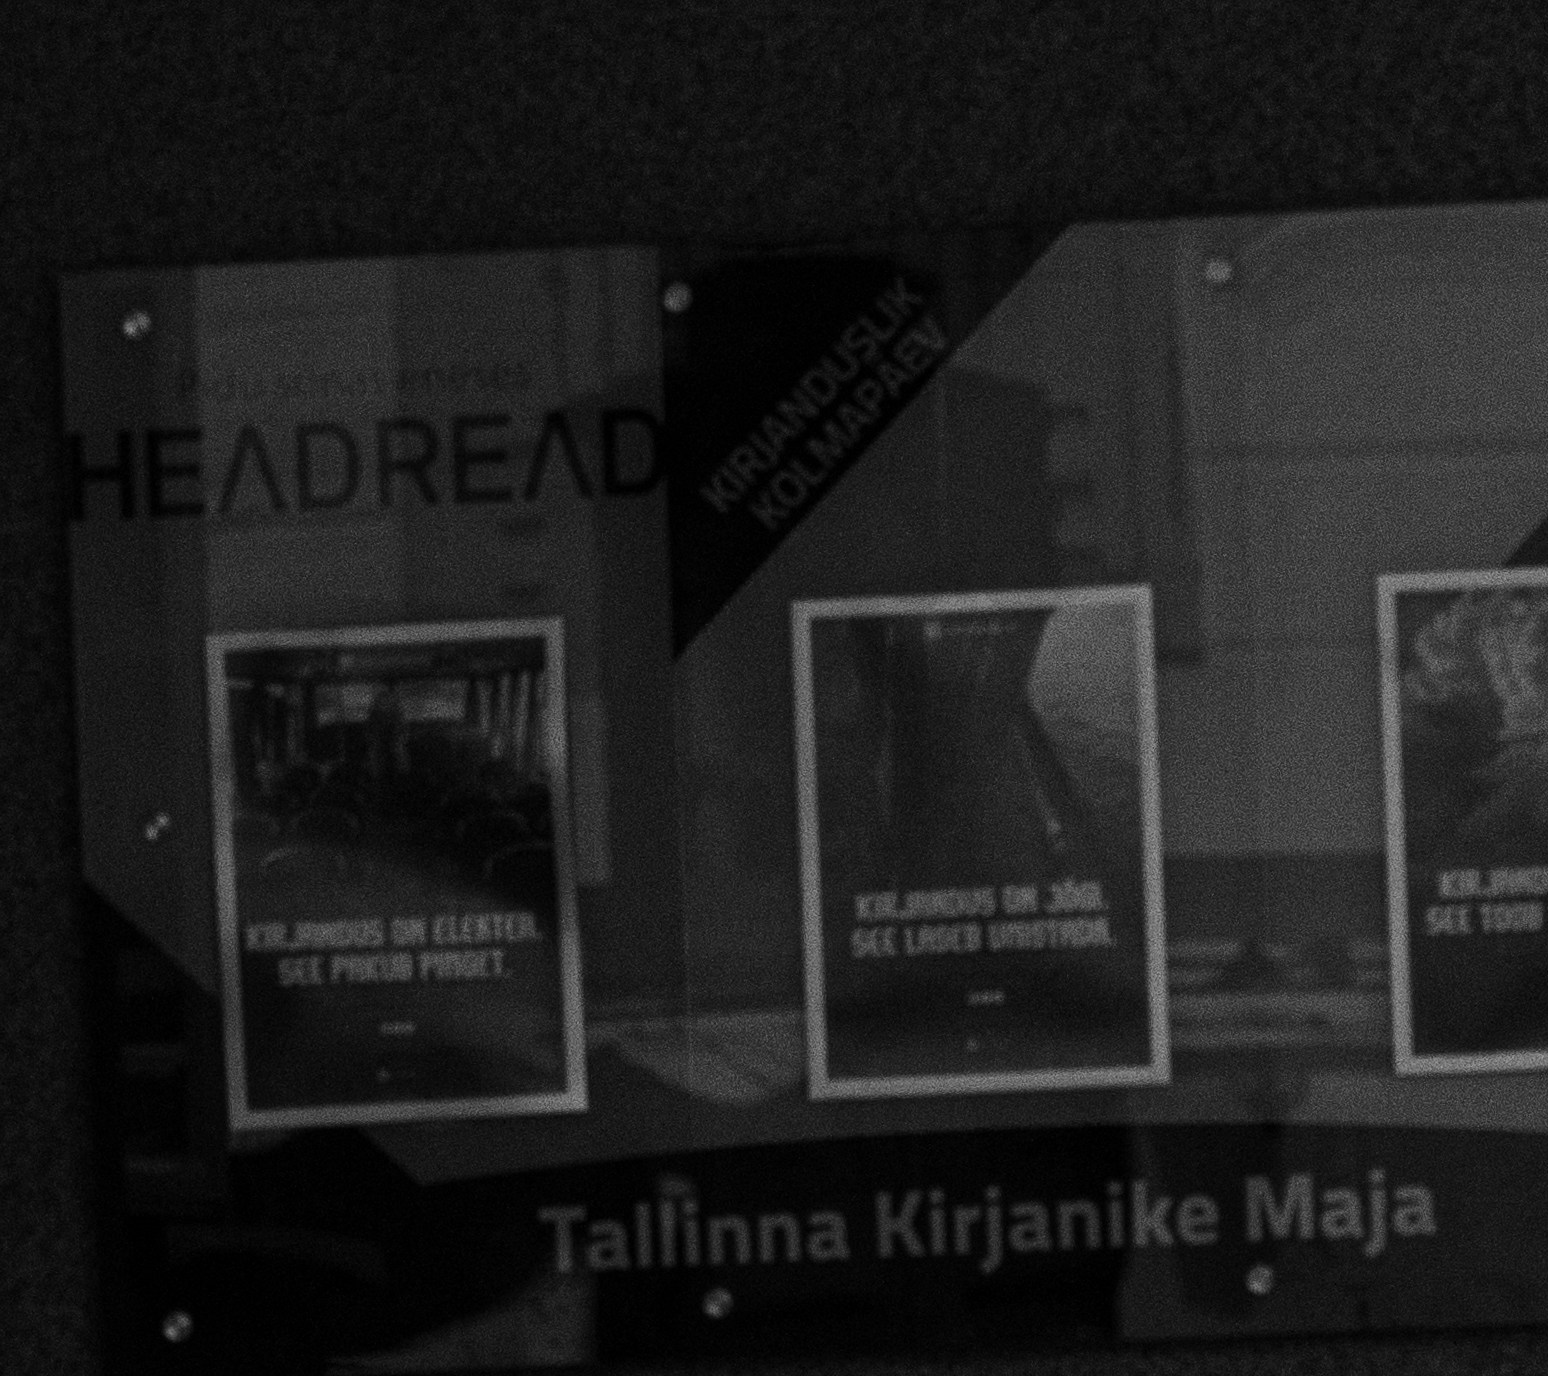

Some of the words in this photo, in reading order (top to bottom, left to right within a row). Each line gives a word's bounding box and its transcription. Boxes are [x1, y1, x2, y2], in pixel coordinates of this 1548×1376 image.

[698, 276, 923, 515] KIRJANDUSLIK
[64, 406, 667, 524] HEADREAD
[1001, 884, 1039, 915] ON
[390, 916, 427, 946] ON
[1425, 903, 1473, 936] SEE
[850, 925, 899, 959] SEE
[277, 954, 324, 987] SEE
[537, 1197, 851, 1276] Tallinna
[874, 1180, 1221, 1274] Kirjanike
[1243, 1166, 1438, 1260] Maja
